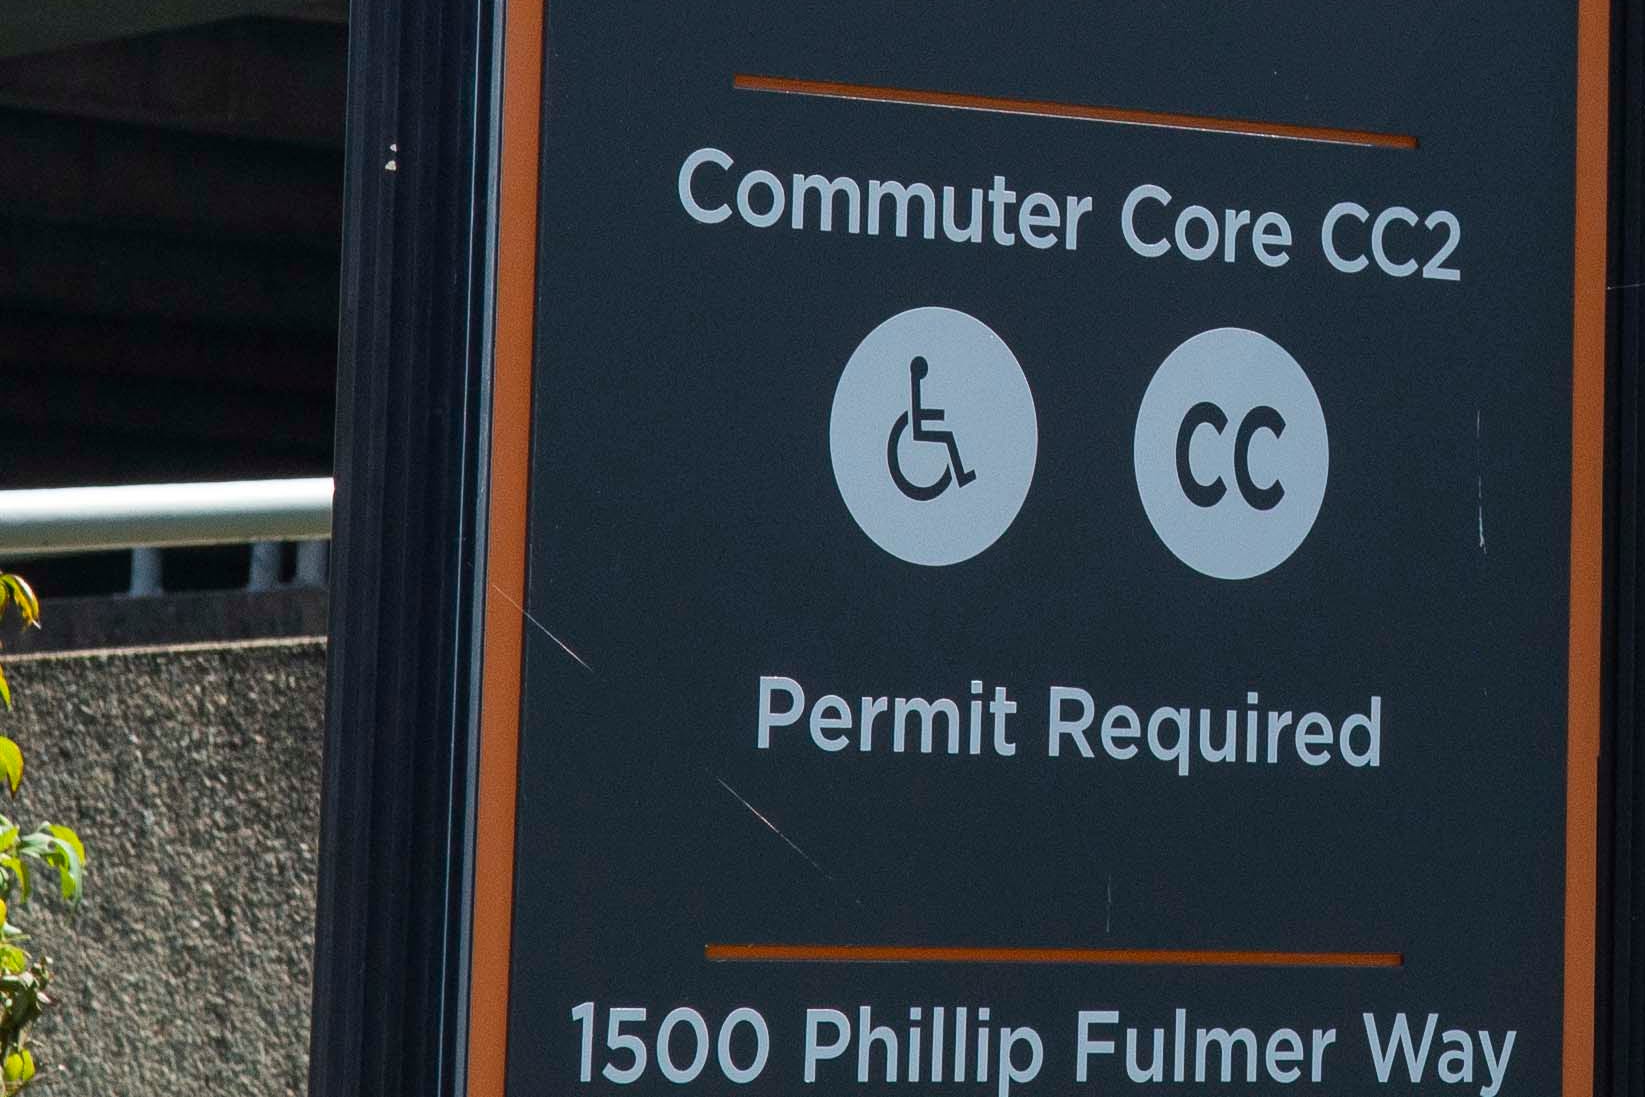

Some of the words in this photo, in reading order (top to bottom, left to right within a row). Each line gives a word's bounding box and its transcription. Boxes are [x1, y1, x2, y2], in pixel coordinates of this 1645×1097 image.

[678, 146, 1092, 251] Commuter
[1120, 183, 1292, 267] Core
[1320, 201, 1461, 281] CC2
[1175, 401, 1287, 511] CC
[757, 675, 1017, 756] Permit
[1048, 685, 1381, 776] Required
[571, 1001, 770, 1084] 1500
[804, 1005, 1044, 1097] Phillip
[1075, 1008, 1337, 1083] Fulmer
[1362, 1012, 1517, 1097] Way
